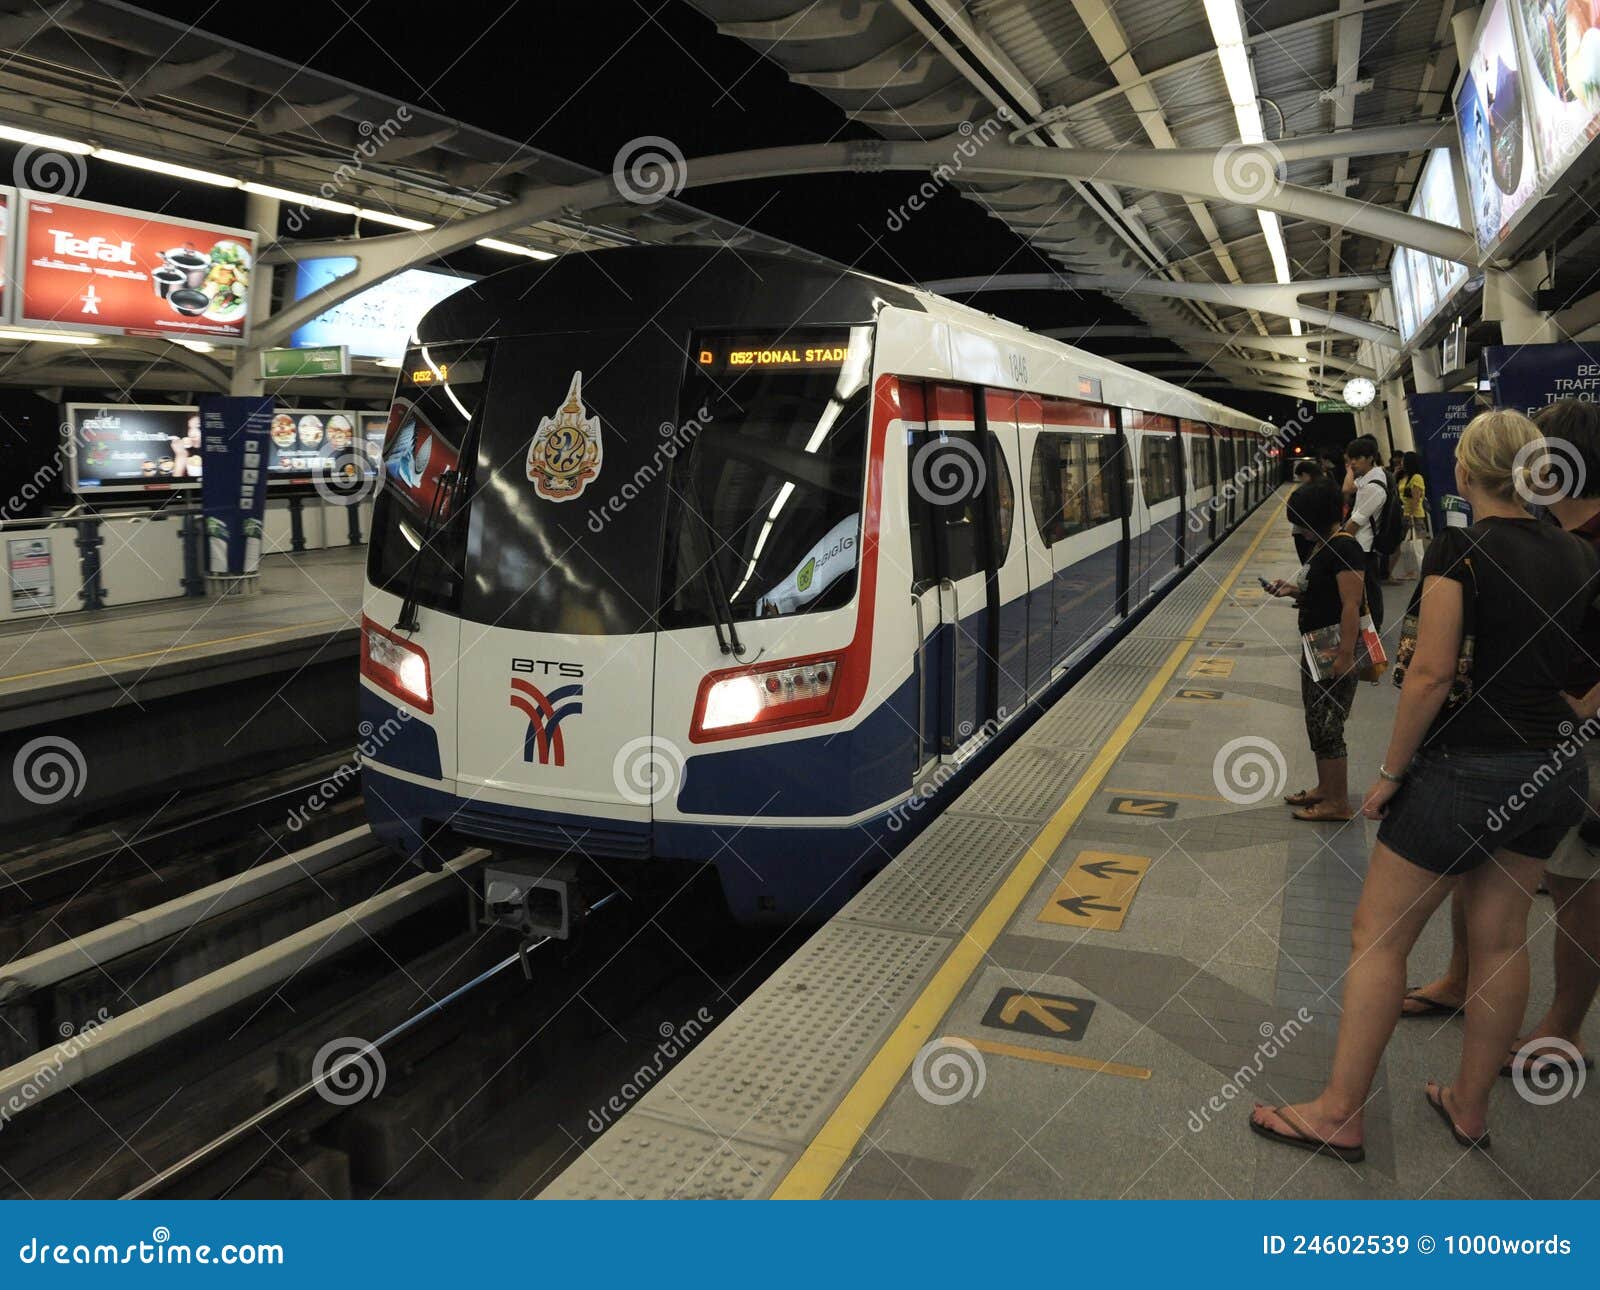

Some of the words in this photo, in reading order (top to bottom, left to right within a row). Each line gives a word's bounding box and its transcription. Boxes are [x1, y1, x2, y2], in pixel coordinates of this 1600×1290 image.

[48, 229, 136, 265] Tefal
[1577, 365, 1600, 376] BE
[512, 658, 584, 678] BTS
